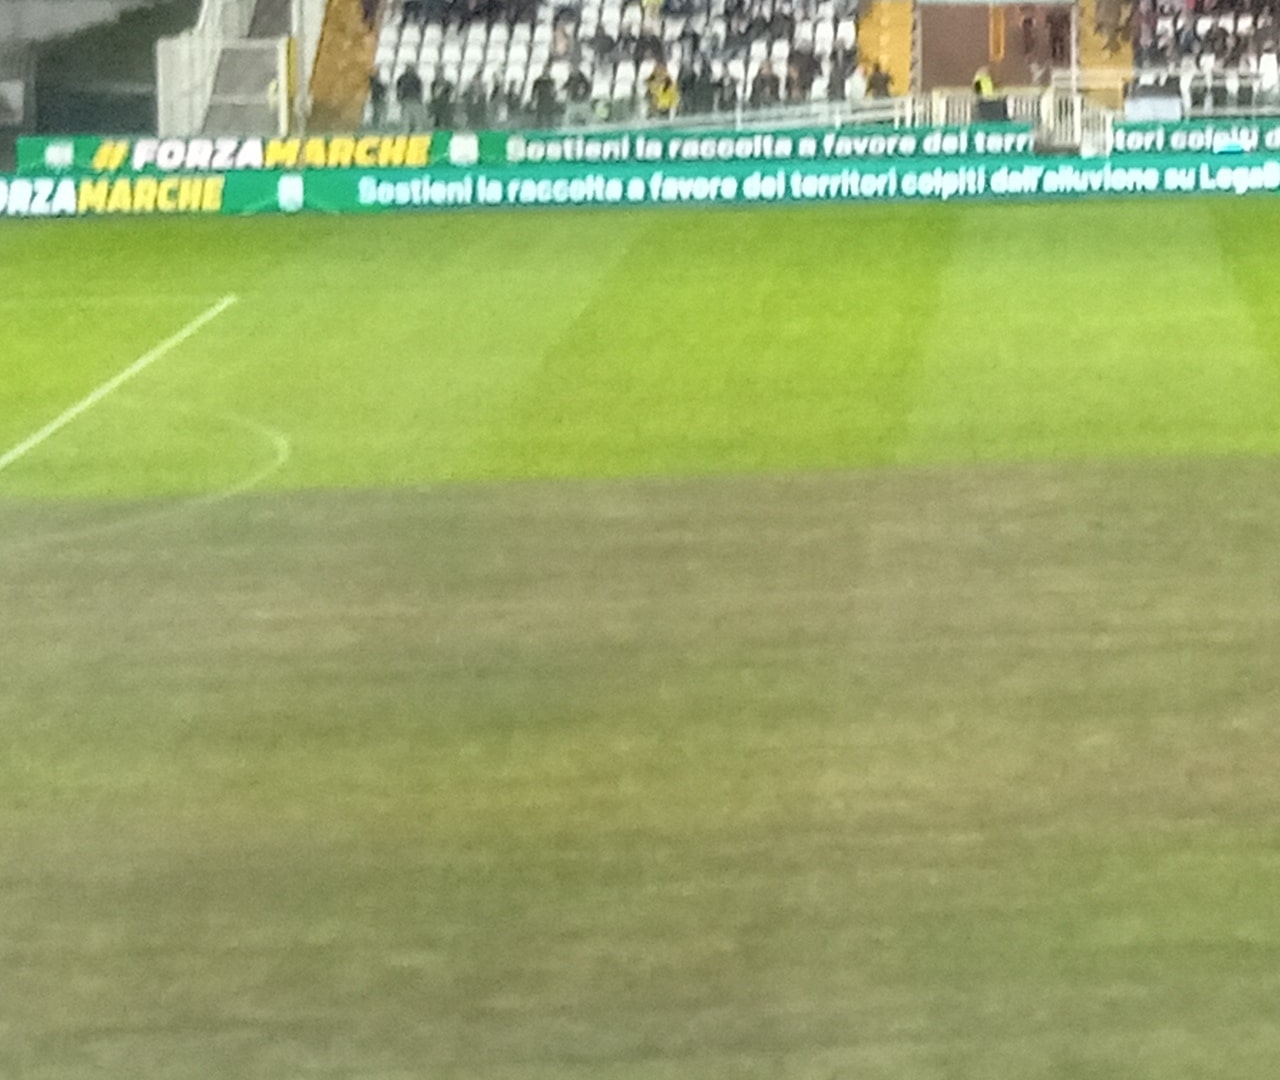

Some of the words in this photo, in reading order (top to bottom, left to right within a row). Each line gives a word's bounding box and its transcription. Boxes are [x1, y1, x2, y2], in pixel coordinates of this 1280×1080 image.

[91, 134, 432, 171] #FORZAMARCHE
[506, 133, 629, 162] Sostieni
[635, 133, 662, 160] la
[668, 132, 792, 160] raccolta
[798, 134, 816, 157] a
[823, 130, 916, 157] favore
[922, 127, 968, 155] dei
[359, 174, 474, 205] Sostieni
[477, 174, 503, 204] la
[508, 173, 623, 204] raccolta
[627, 176, 645, 203] a
[650, 170, 738, 202] favore
[743, 167, 785, 200] dei
[790, 165, 897, 199] territori
[901, 164, 985, 201] colpiti
[990, 162, 1159, 194] dall'alluvione
[1164, 166, 1196, 192] su
